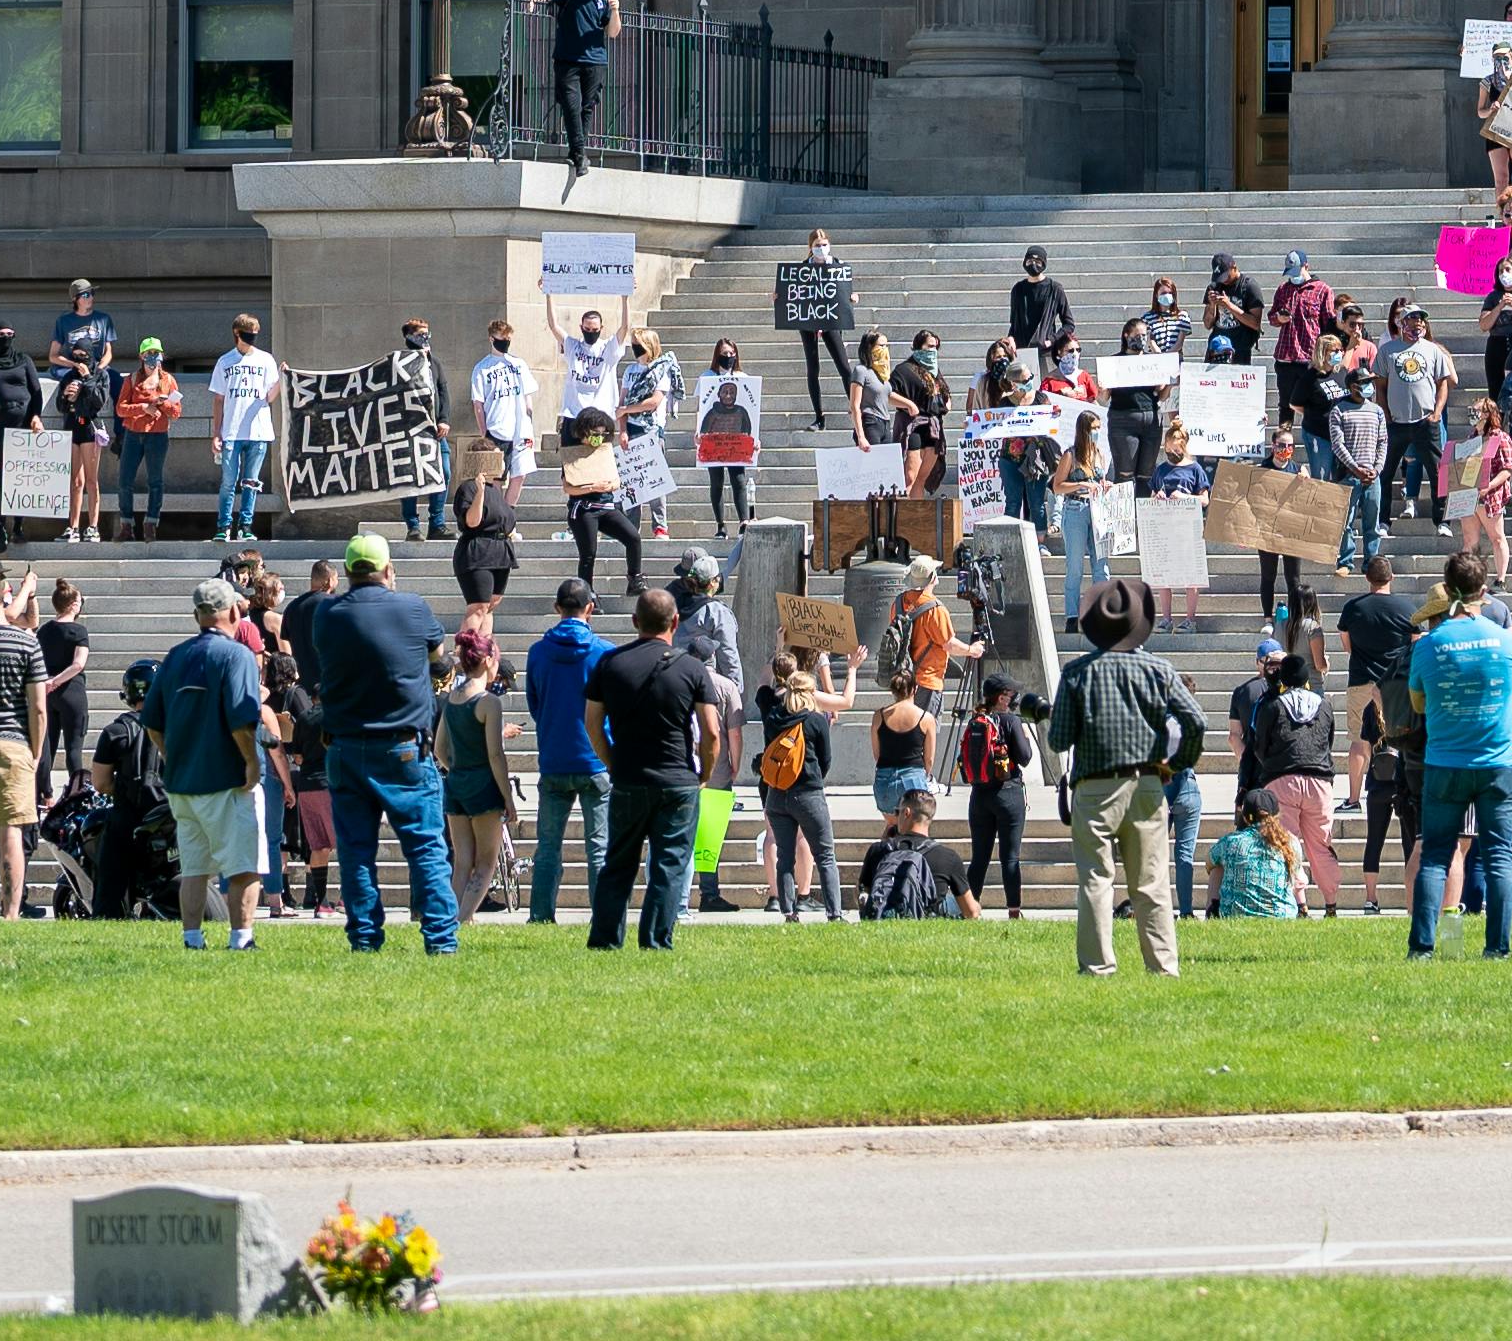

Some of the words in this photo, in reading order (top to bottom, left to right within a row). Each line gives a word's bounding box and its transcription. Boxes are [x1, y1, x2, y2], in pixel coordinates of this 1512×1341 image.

[780, 266, 853, 283] LEGALIZE
[787, 282, 837, 301] BEING
[786, 303, 839, 322] BLACK
[224, 365, 263, 379] JUSTICE
[292, 351, 420, 408] BLACK
[229, 388, 260, 399] FLOYD
[302, 388, 435, 453] LIVES
[11, 430, 64, 450] STOP
[985, 439, 999, 449] DO
[1207, 433, 1226, 443] LIVES
[1227, 444, 1262, 455] MATTER
[964, 451, 986, 462] YOU
[4, 460, 72, 475] OPPRESSION
[289, 436, 444, 497] MATTER
[960, 461, 984, 475] WHEN
[13, 474, 51, 487] STOP
[789, 598, 825, 621] BLACK
[808, 635, 833, 650] TOO!
[1434, 638, 1501, 654] VOLUNTEER
[86, 1215, 148, 1245] DESERT
[159, 1215, 223, 1245] STORM
